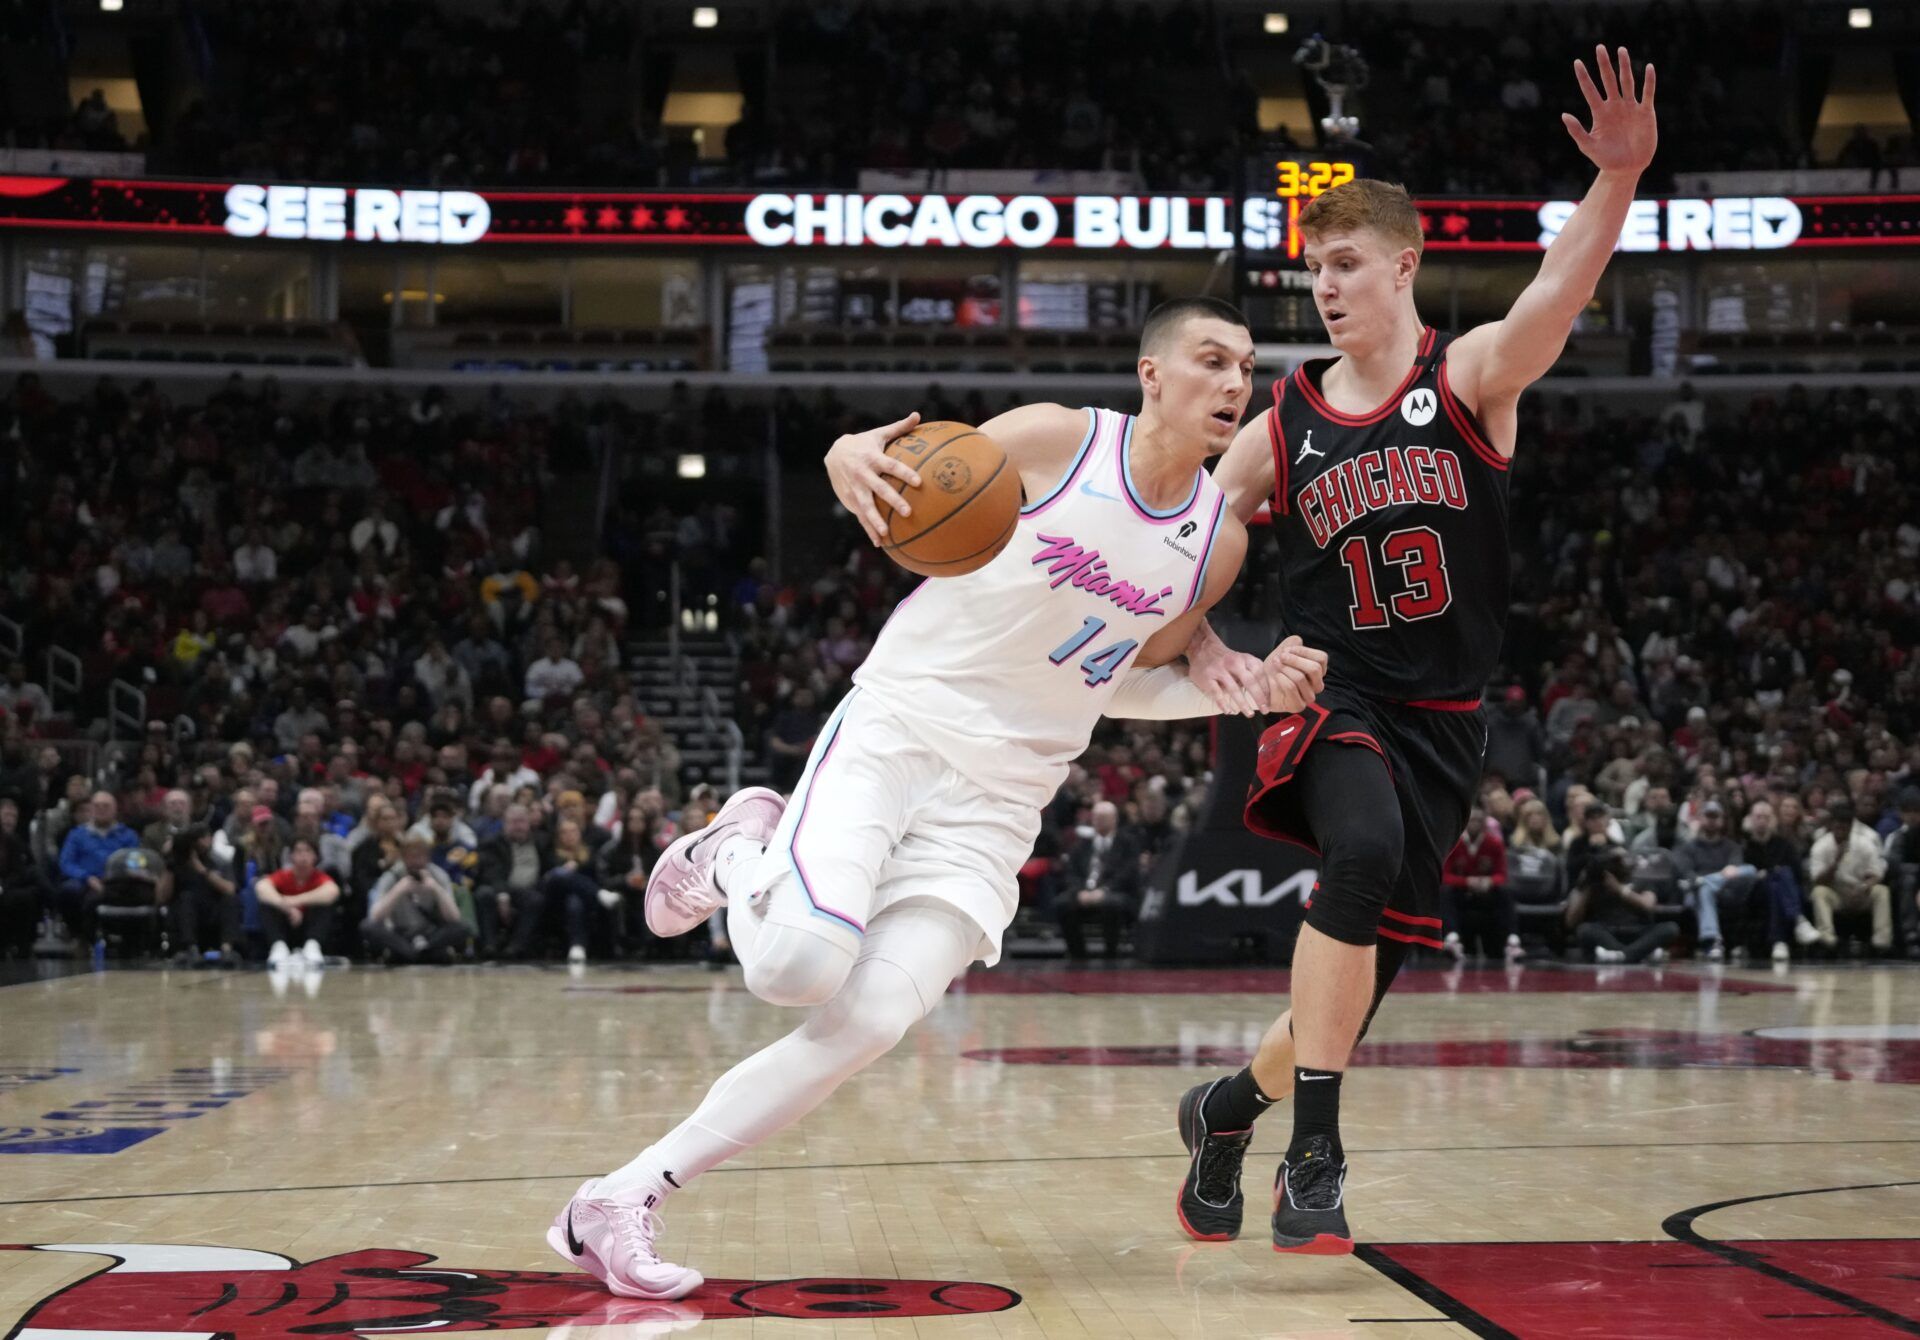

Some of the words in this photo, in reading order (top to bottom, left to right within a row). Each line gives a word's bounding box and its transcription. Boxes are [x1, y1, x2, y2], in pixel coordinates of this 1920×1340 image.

[1276, 161, 1355, 197] 3:22
[224, 184, 347, 240] SEE
[353, 189, 491, 244] RED
[744, 193, 1059, 248] CHICAGO
[1537, 200, 1660, 252] SE
[1666, 197, 1803, 250] RED
[1298, 446, 1468, 549] CHICAGO
[1032, 532, 1173, 616] Miami
[1163, 536, 1198, 562] Robinhood
[1340, 526, 1452, 630] 13
[1048, 615, 1139, 689] 14
